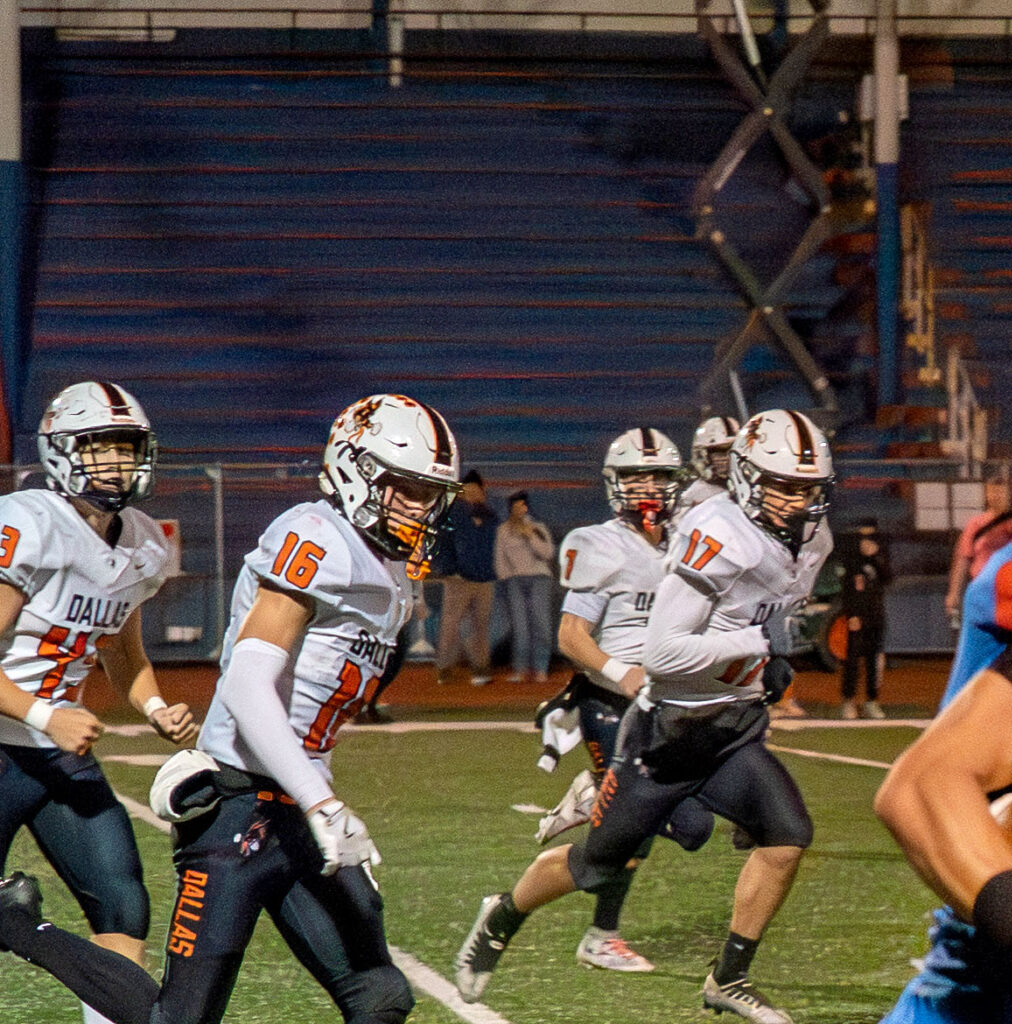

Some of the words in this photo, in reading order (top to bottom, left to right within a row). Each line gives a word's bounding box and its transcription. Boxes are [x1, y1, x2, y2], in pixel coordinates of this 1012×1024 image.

[271, 531, 327, 589] 16
[564, 549, 578, 581] 1
[681, 528, 723, 570] 17
[168, 869, 209, 957] DALLAS
